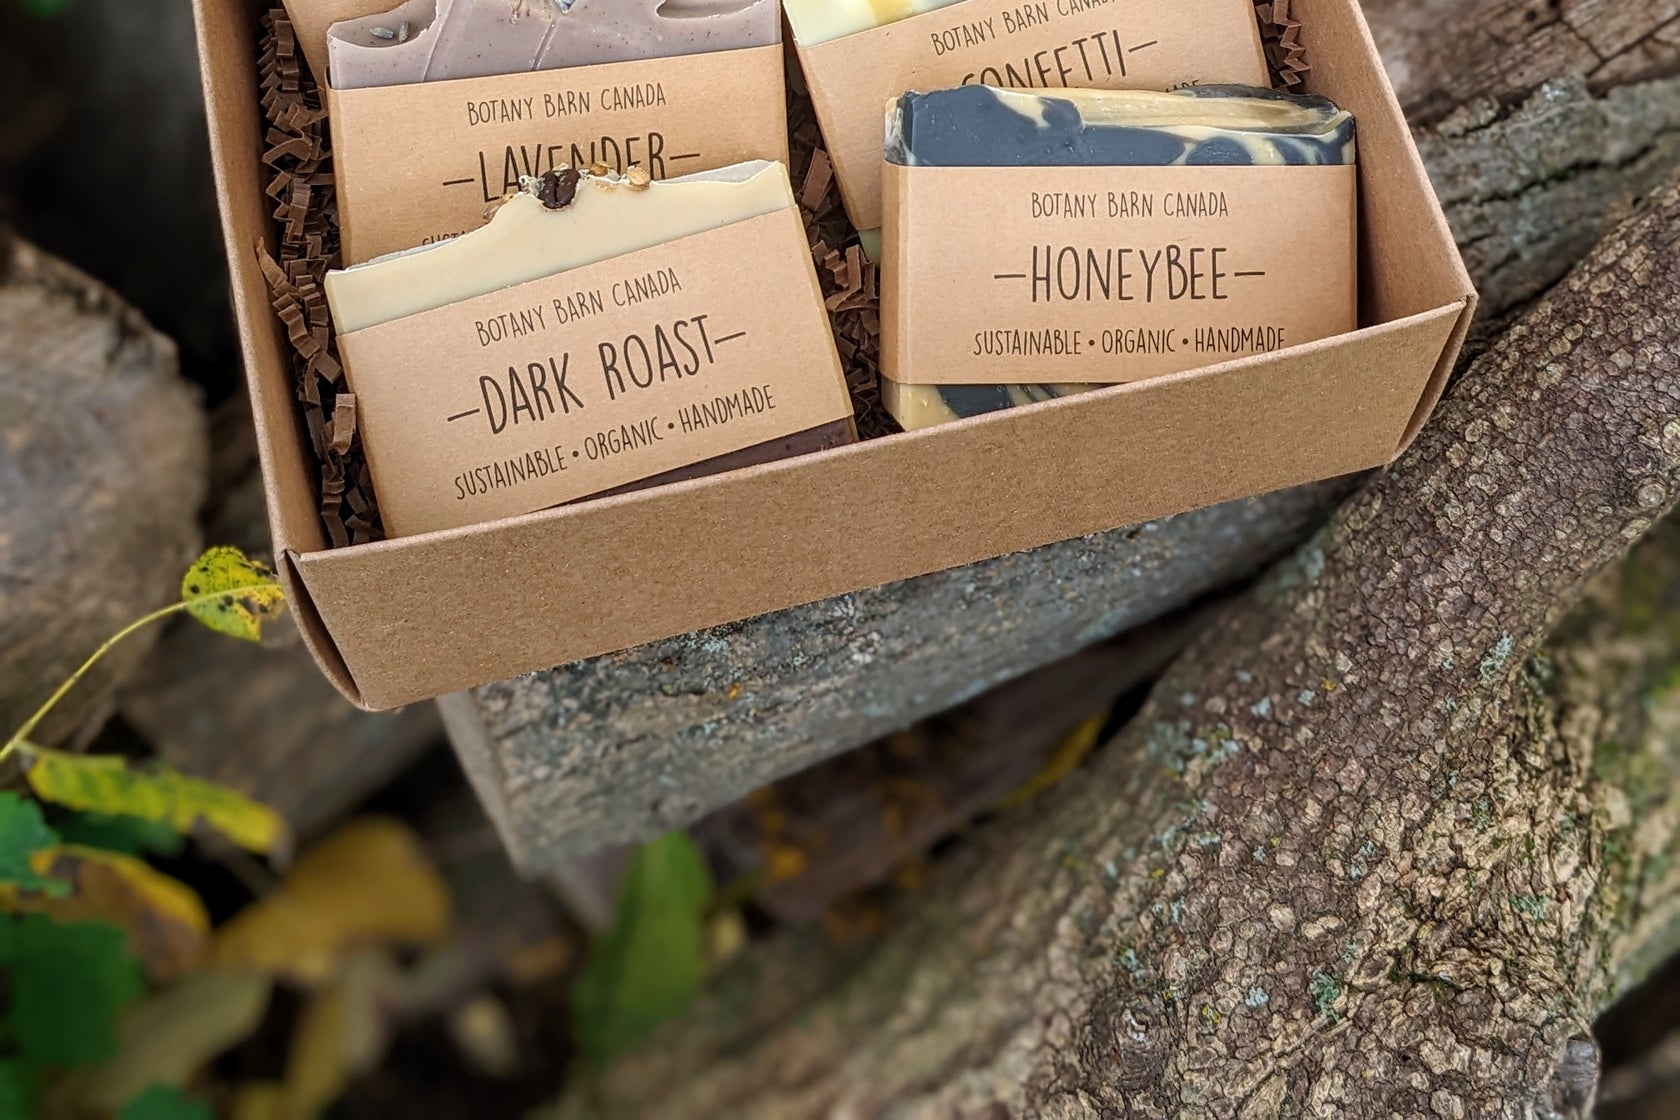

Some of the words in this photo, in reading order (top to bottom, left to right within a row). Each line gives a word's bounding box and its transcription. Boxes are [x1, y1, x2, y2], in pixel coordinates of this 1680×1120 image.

[930, 17, 996, 57] BOTANY
[1001, 3, 1050, 35] BARN
[466, 96, 534, 127] BOTANY
[543, 90, 590, 118] BARN
[600, 81, 667, 112] CANADA
[1031, 191, 1097, 219] BOTANY
[1107, 190, 1154, 219] BARN
[1163, 191, 1229, 219] CANADA
[1031, 244, 1229, 304] HONEYBEE
[474, 304, 546, 347] BOTANY
[552, 289, 604, 325] BARN
[611, 266, 683, 307] CANADA
[972, 328, 1082, 356] SUSTAINABLE
[1101, 327, 1176, 356] ORGANIC
[1194, 325, 1285, 354] HANDMADE
[479, 352, 585, 435] DARK
[598, 314, 715, 401] ROAST
[454, 445, 569, 501] SUSTAINABLE
[584, 415, 664, 461] ORGANIC
[678, 384, 777, 434] HANDMADE
